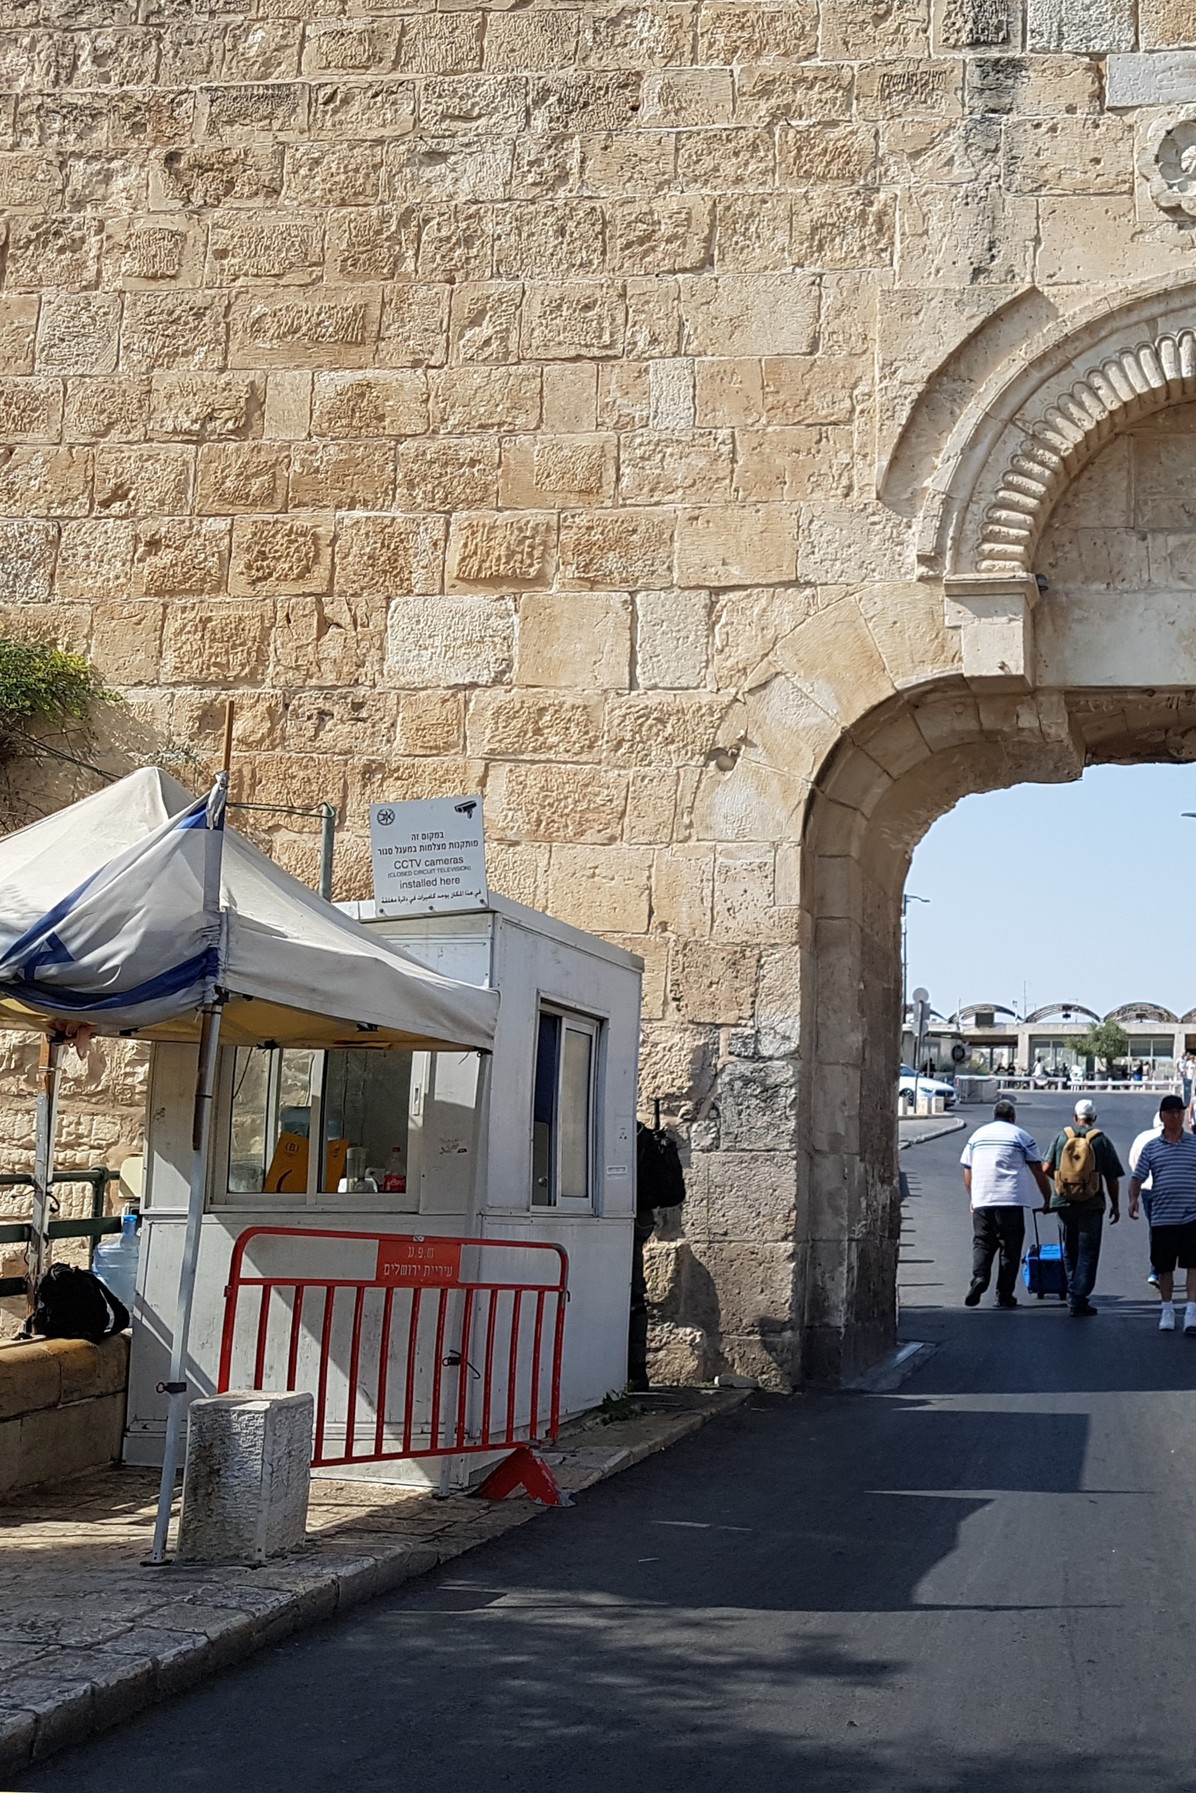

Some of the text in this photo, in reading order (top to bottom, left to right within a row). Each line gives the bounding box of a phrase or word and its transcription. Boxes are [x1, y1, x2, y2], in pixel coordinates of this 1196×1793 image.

[411, 831, 444, 841] במקום זה
[377, 839, 479, 856] מותקנות מצלמות במעגל סגור
[393, 856, 464, 870] CCTV cameras
[399, 876, 461, 889] installed here
[474, 888, 482, 898] في
[383, 1262, 453, 1278] עיריית ירושלים
